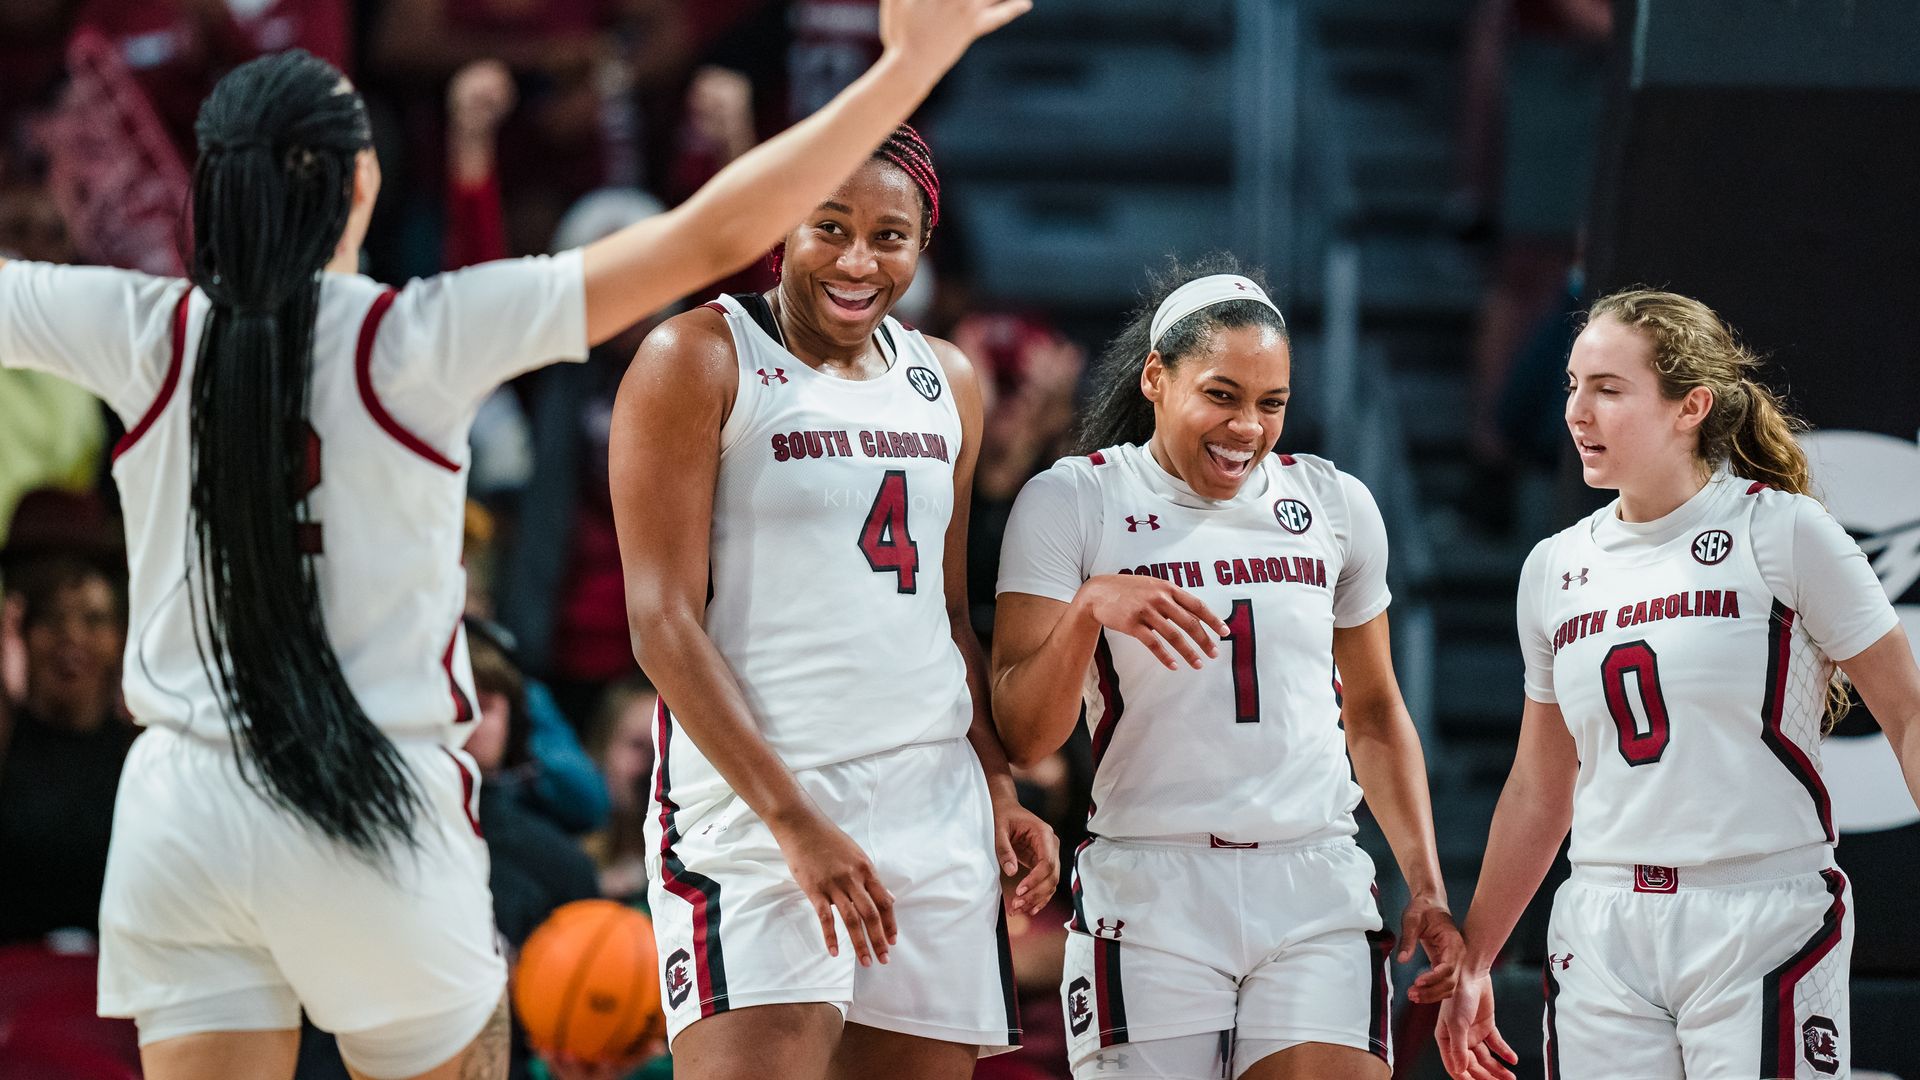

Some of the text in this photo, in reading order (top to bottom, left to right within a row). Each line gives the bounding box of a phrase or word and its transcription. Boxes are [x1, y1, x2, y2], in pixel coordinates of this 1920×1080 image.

[911, 367, 940, 400] SEC
[771, 431, 950, 464] SOUTH CAROLINA
[857, 469, 919, 594] 4
[1278, 500, 1310, 532] SEC
[1693, 531, 1730, 564] SEC
[1118, 556, 1327, 588] UTH CAROLINA
[1616, 590, 1740, 628] CAROLINA
[1220, 598, 1260, 723] 1
[1600, 638, 1670, 768] 0
